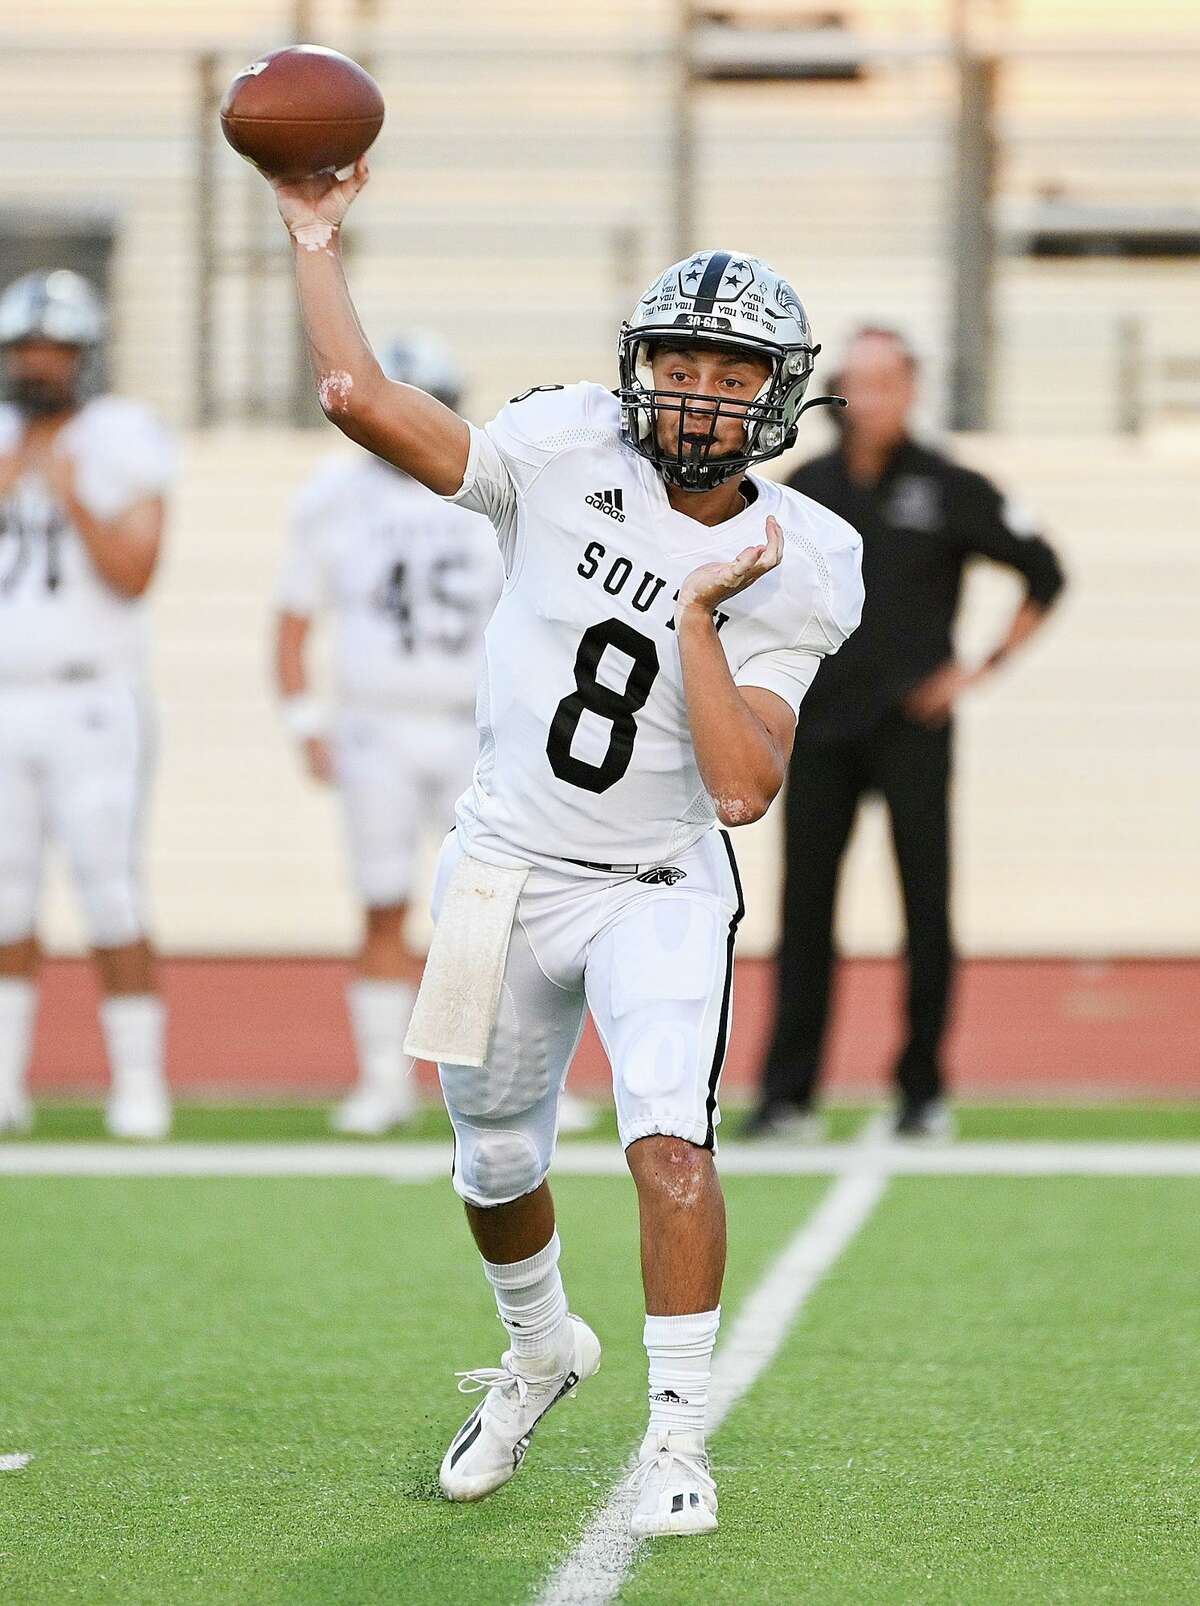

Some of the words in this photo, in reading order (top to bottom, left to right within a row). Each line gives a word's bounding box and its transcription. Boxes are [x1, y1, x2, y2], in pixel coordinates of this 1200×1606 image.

[585, 495, 626, 523] adidas
[577, 541, 730, 632] SOU
[546, 617, 660, 795] 8
